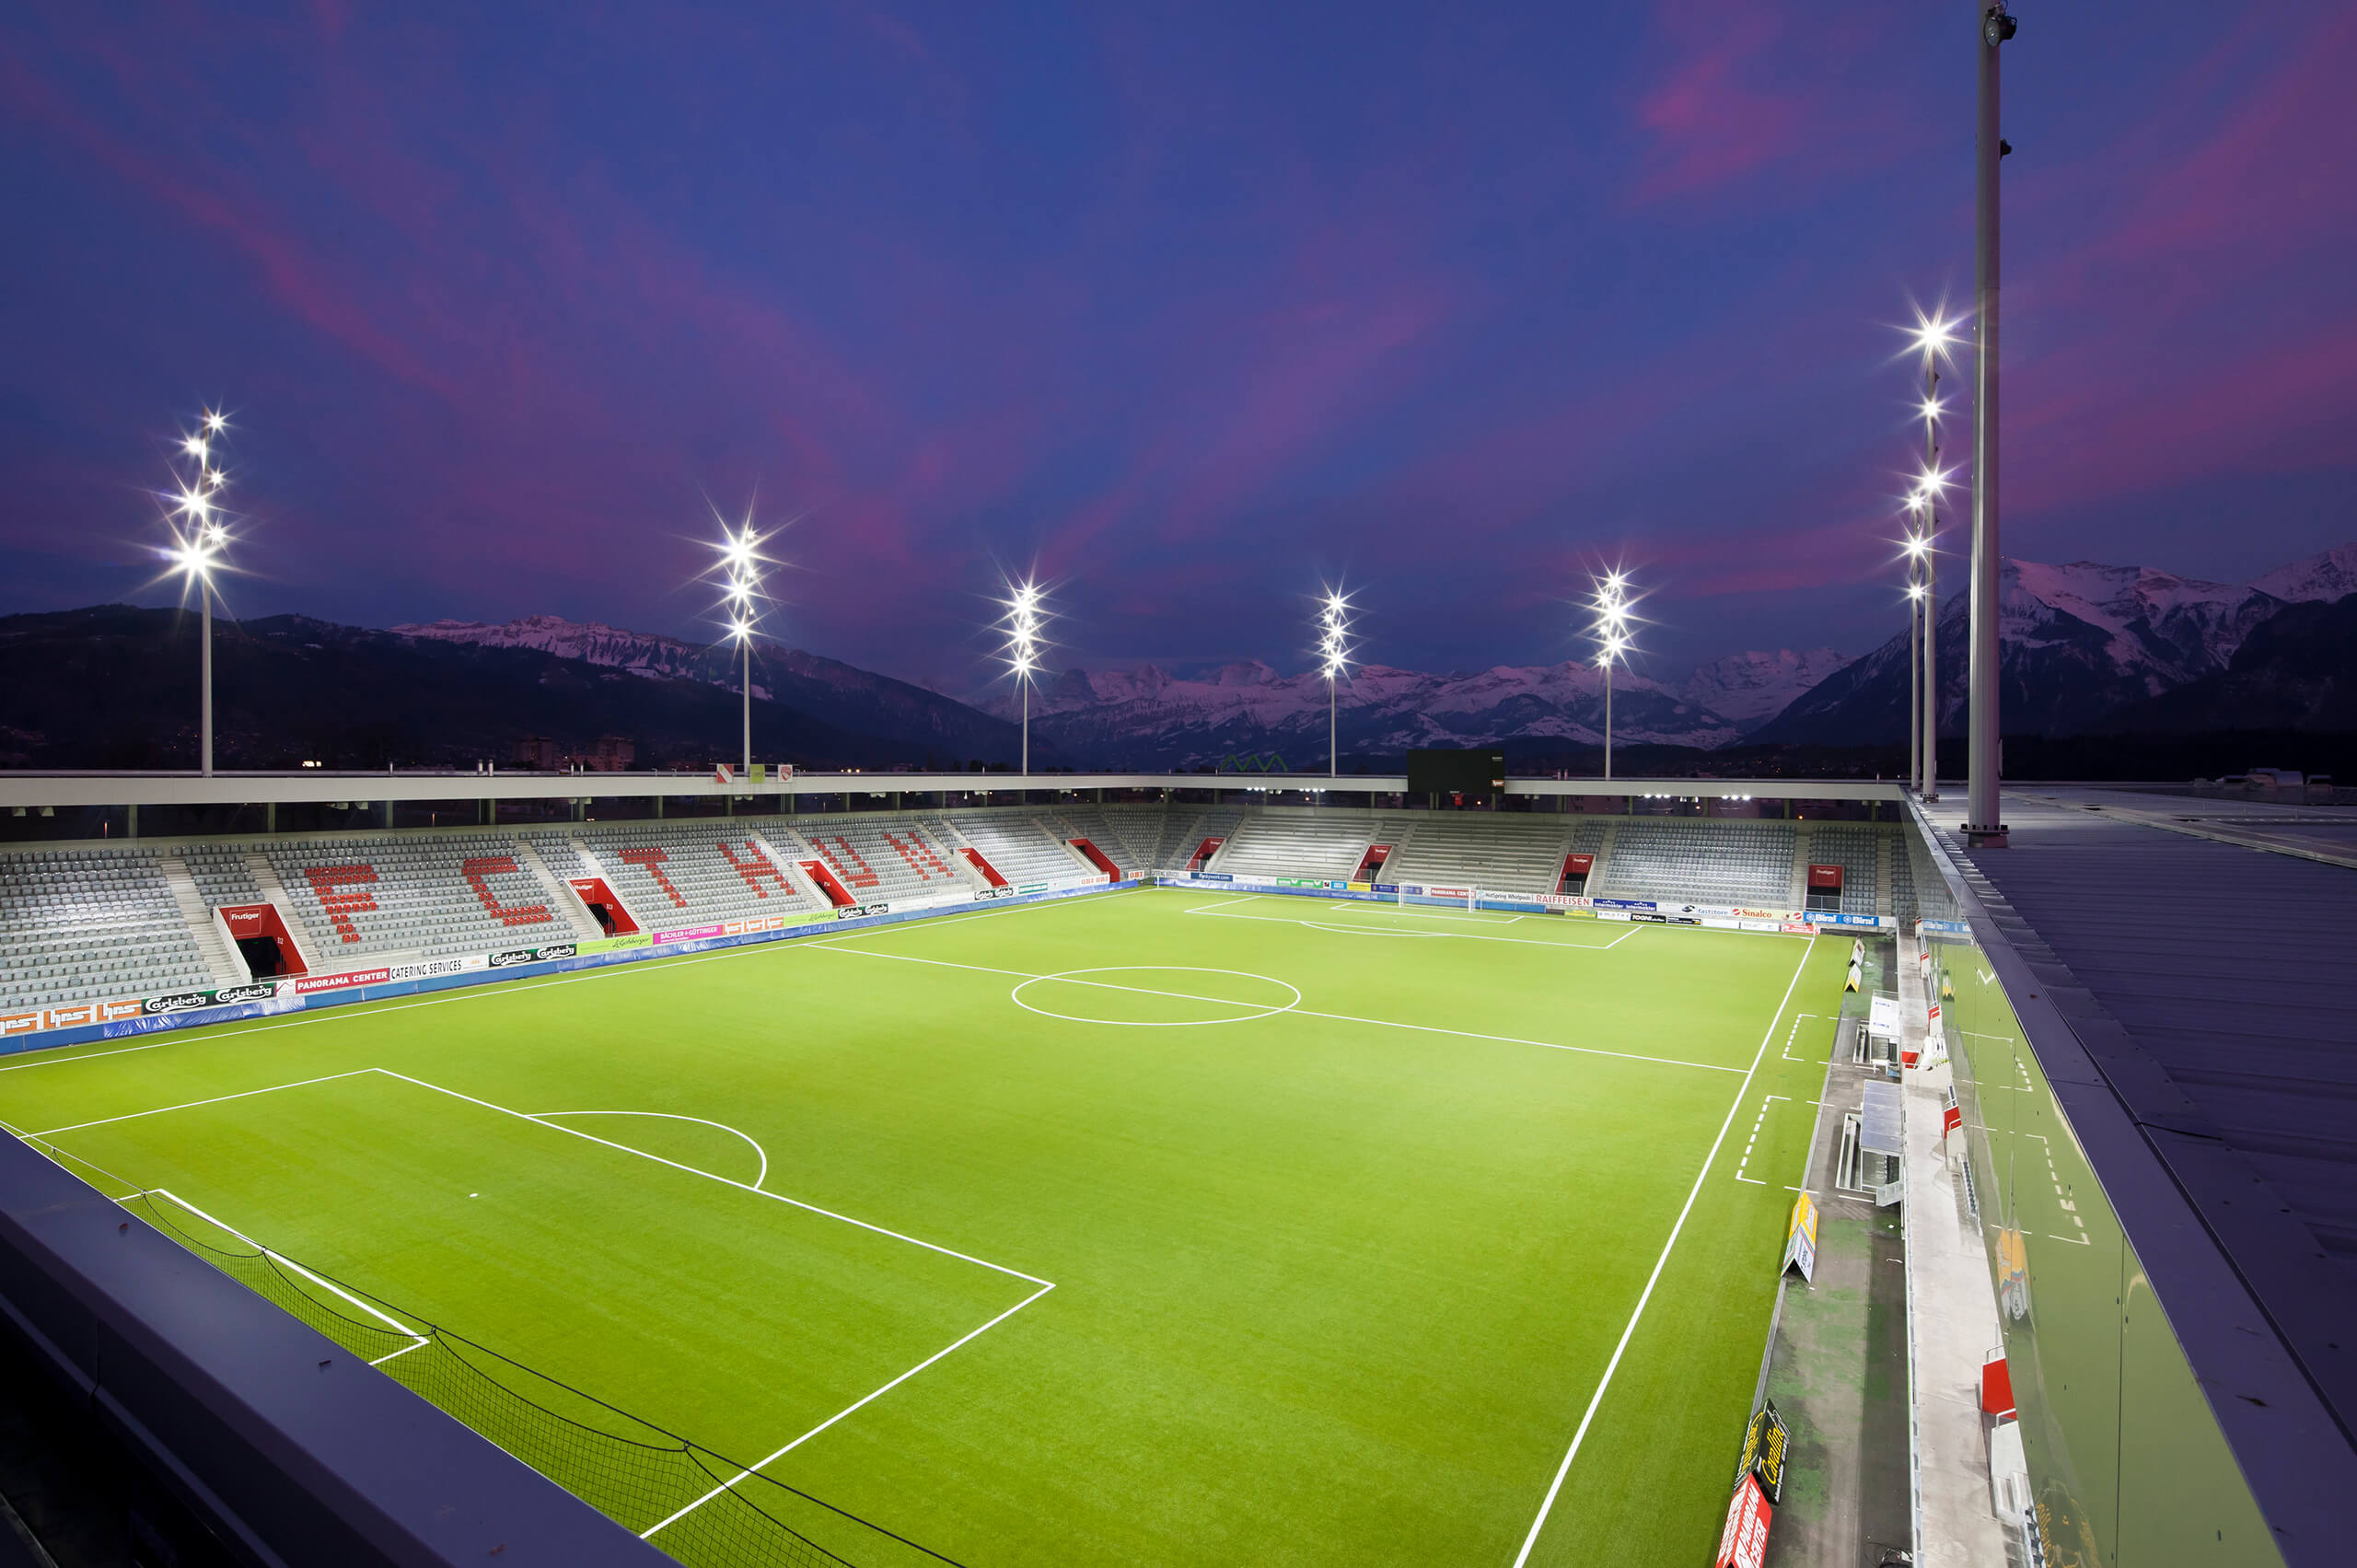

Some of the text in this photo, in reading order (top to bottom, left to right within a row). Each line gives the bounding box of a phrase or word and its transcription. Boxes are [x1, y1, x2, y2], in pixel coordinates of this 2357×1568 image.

[1536, 894, 1590, 906] RAIFFEISEN
[1742, 908, 1772, 919] Sinalco
[1815, 913, 1875, 925] Biral Biral
[491, 951, 531, 966] Carlsberg
[536, 945, 575, 959] Carlsberg
[391, 959, 462, 980] CATERING SERVICES
[297, 970, 388, 991] PANORAMA CENTER
[215, 984, 273, 1003] Carlsberg
[145, 993, 206, 1013] Carlsberg
